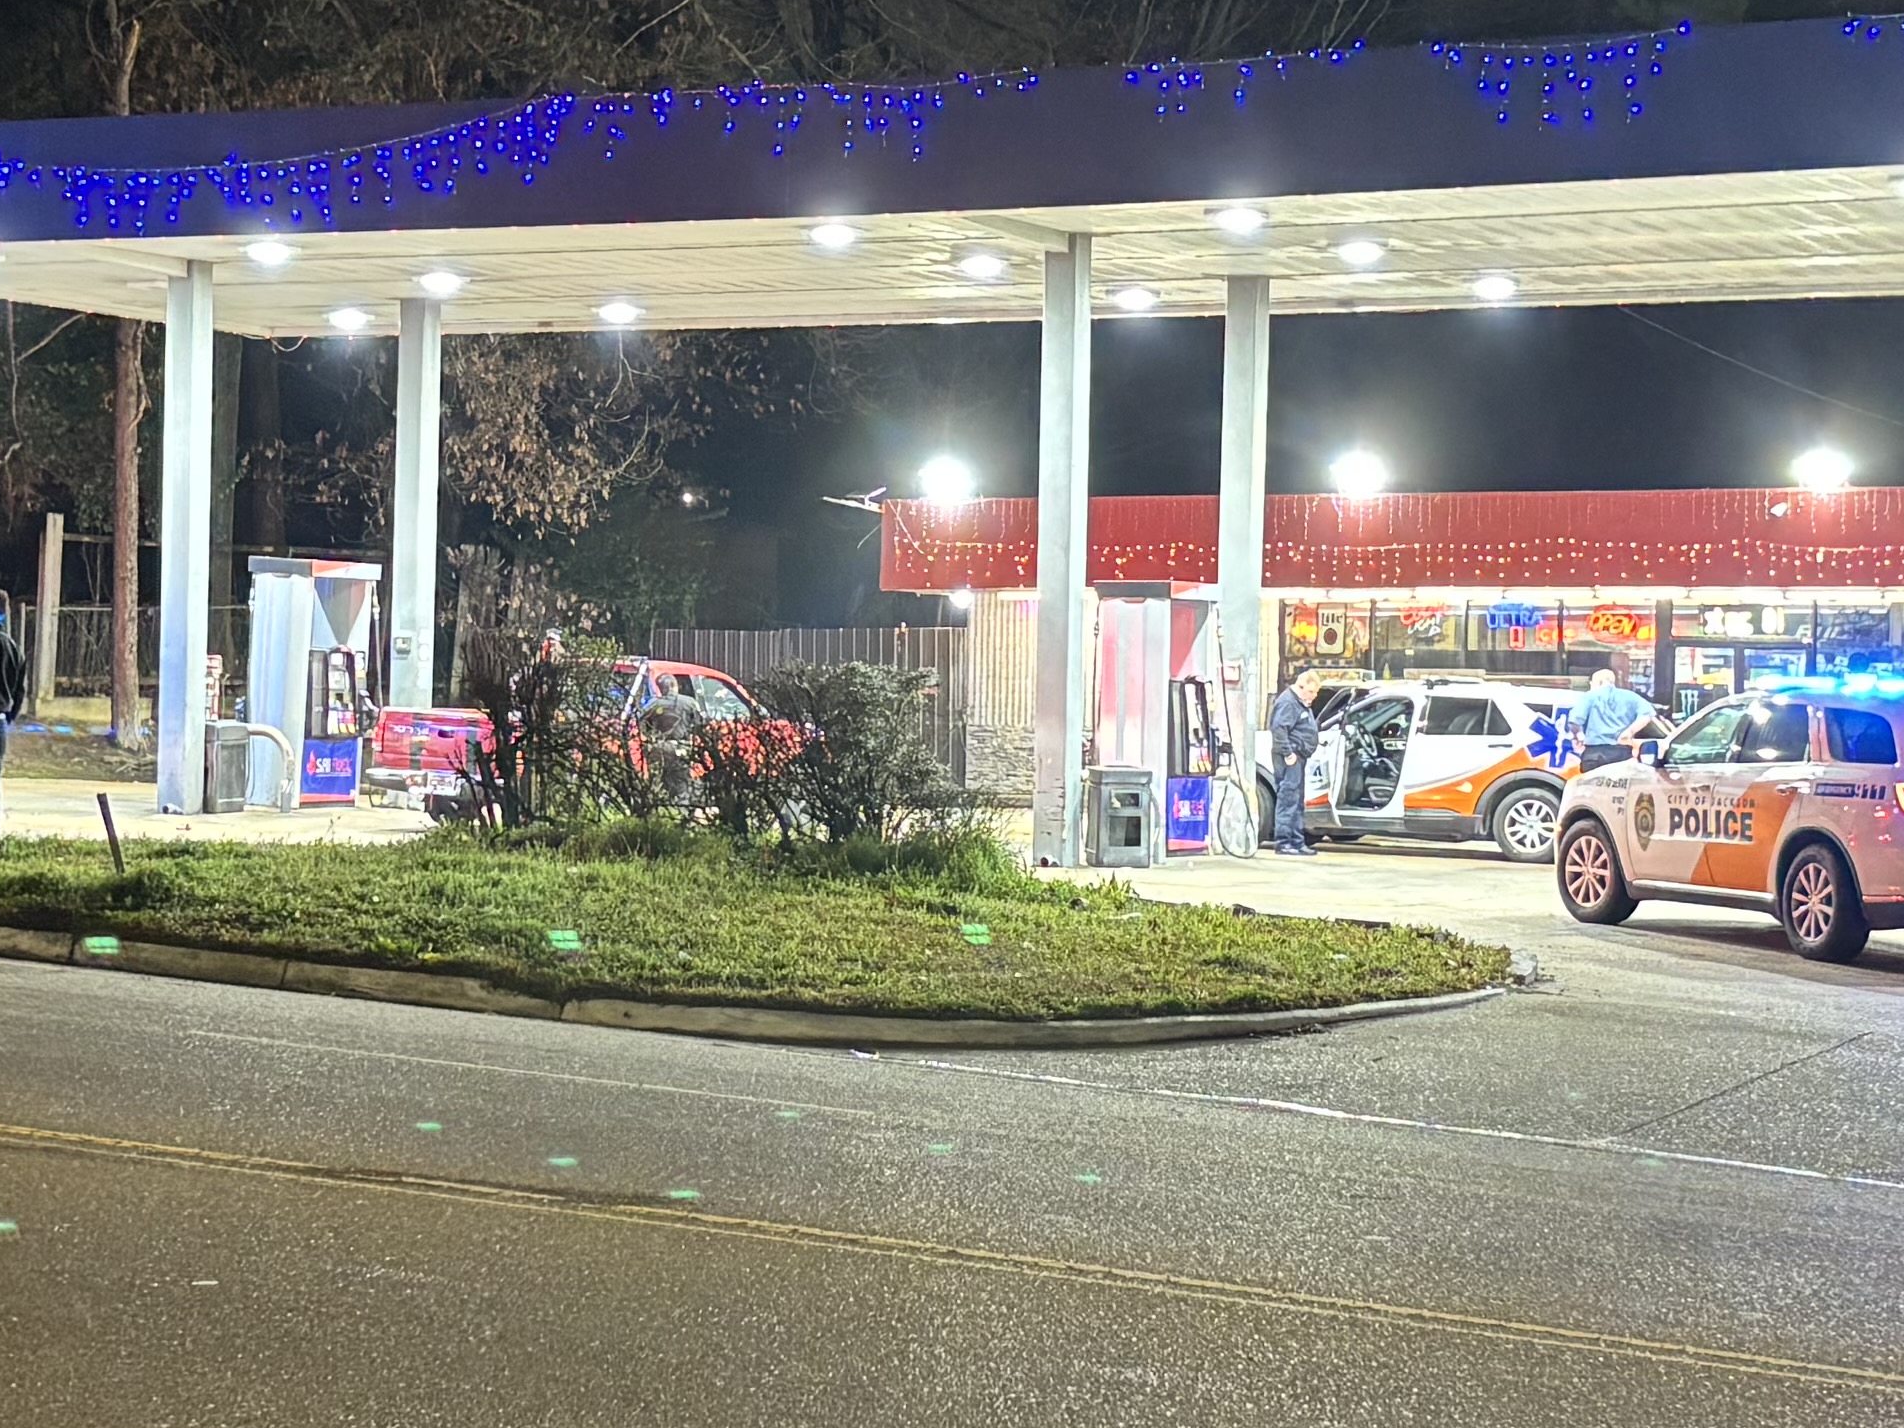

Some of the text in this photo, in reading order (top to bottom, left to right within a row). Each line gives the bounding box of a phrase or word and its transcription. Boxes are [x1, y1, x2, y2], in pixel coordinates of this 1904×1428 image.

[1486, 609, 1543, 629] ULTRA
[1589, 613, 1636, 636] OPEN
[1667, 794, 1756, 809] CITY OF JACKSON
[1668, 807, 1754, 842] POLICE
